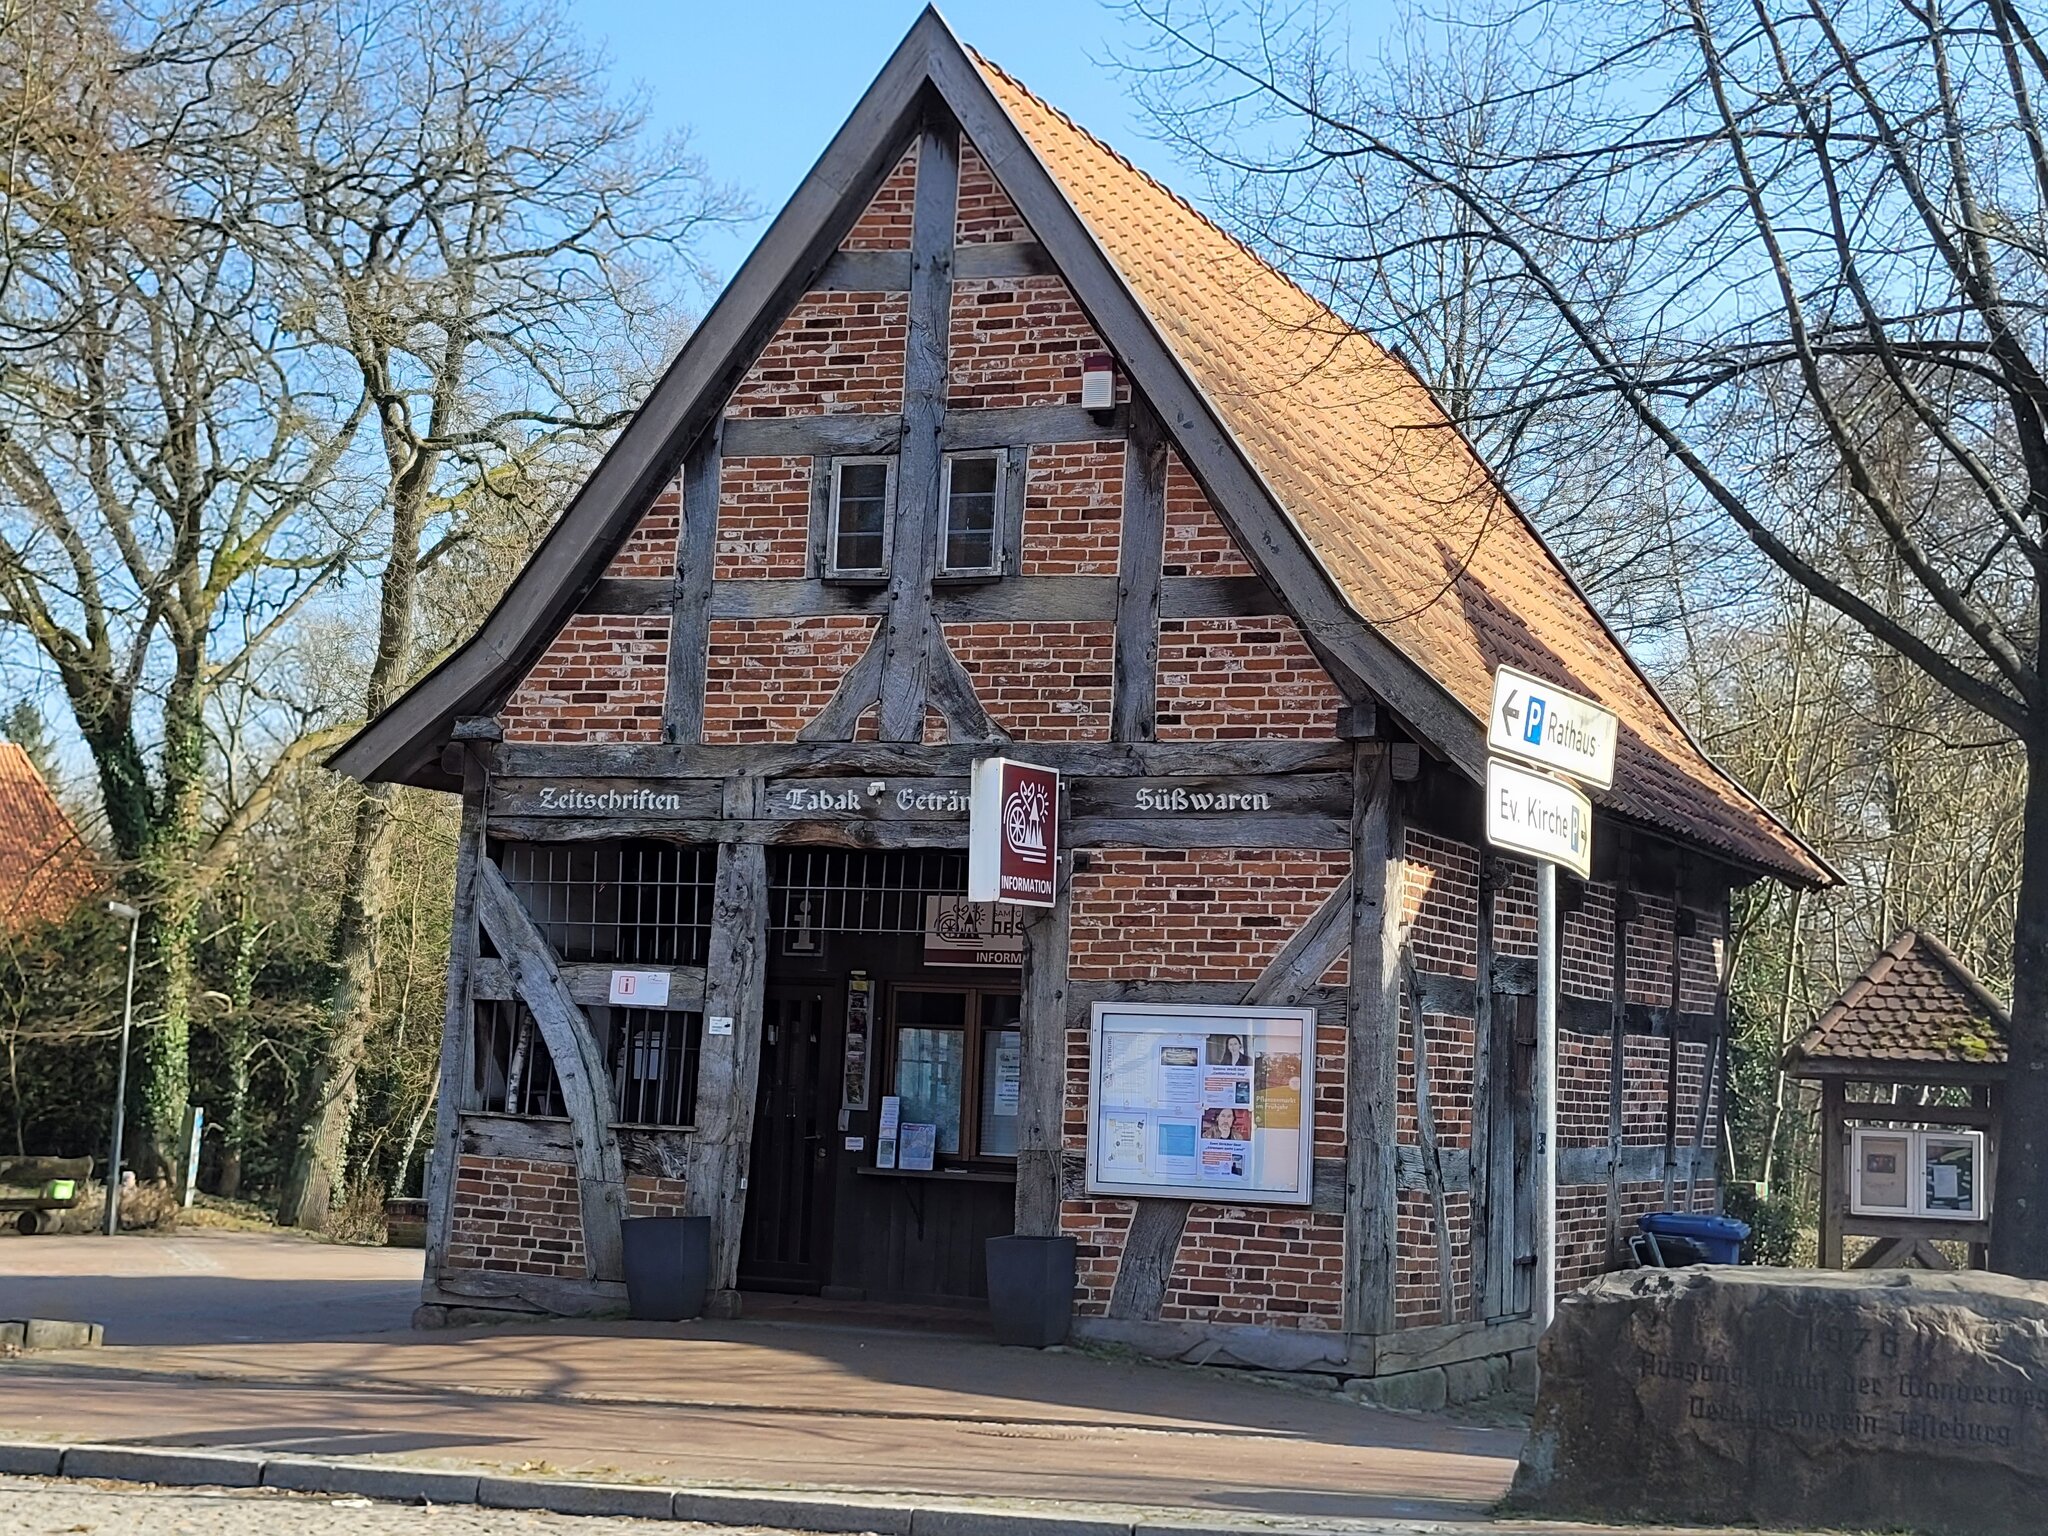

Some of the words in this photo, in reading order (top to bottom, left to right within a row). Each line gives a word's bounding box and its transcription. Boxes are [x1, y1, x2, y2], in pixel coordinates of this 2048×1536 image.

[1547, 711, 1597, 758] Rathaus
[538, 786, 681, 811] Zeitschriften
[785, 787, 863, 811] Tabak
[1134, 787, 1272, 811] Süßwaren
[1501, 789, 1521, 824] Ev.
[1527, 796, 1569, 839] Kirche
[1001, 875, 1052, 894] INFORMATION
